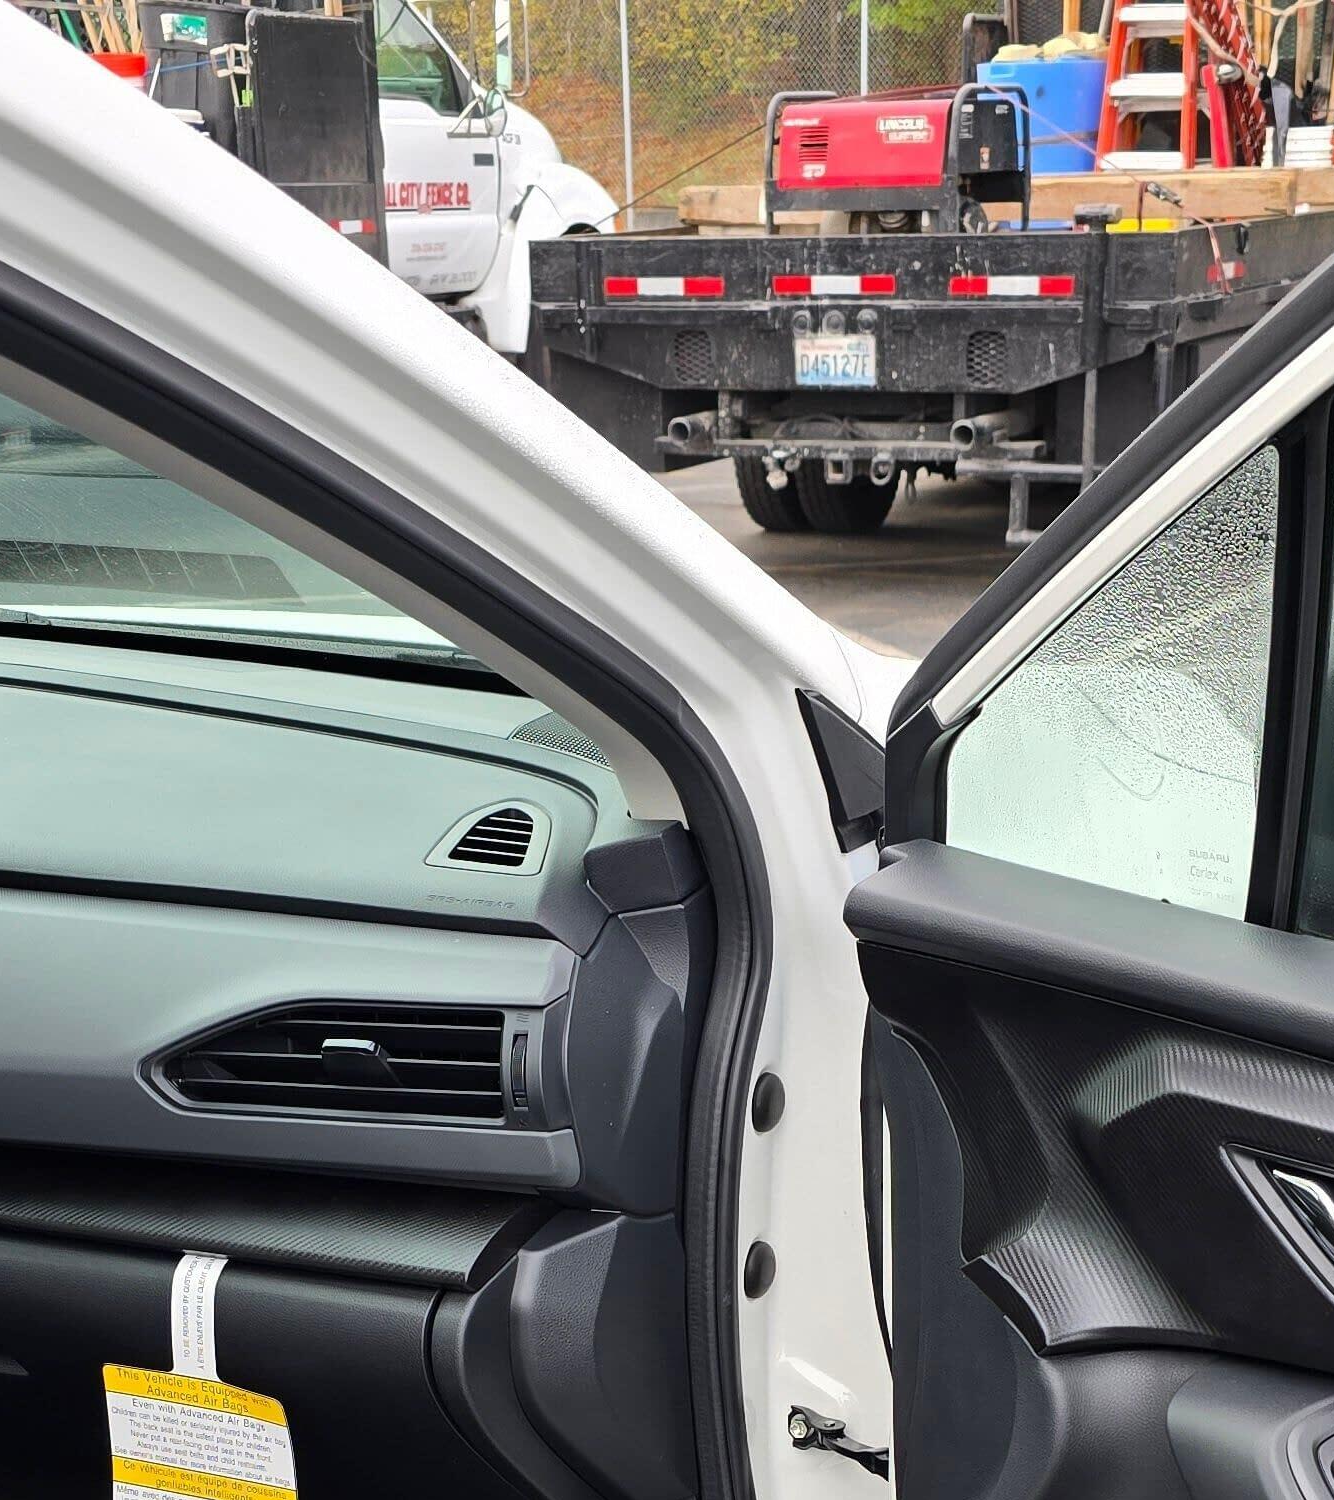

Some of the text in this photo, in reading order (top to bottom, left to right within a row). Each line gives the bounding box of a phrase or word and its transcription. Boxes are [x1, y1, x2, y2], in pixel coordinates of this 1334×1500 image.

[879, 118, 924, 130] LINCOLN
[399, 182, 422, 207] CITY
[426, 182, 453, 206] FENCE
[1189, 848, 1230, 864] SUBARU
[116, 1368, 139, 1381] This
[143, 1371, 183, 1388] Vehicle
[187, 1378, 197, 1390] is
[201, 1381, 248, 1402] Equipped
[147, 1385, 249, 1415] Advanced Air Bags
[112, 1407, 137, 1418] Children
[163, 1415, 179, 1426] killed
[132, 1398, 265, 1433] Even with Advanced Air Bags
[123, 1460, 136, 1471] Ce
[180, 1472, 194, 1481] est
[246, 1485, 287, 1500] coussins
[155, 1479, 202, 1494] gonflables
[142, 1490, 160, 1500] avec
